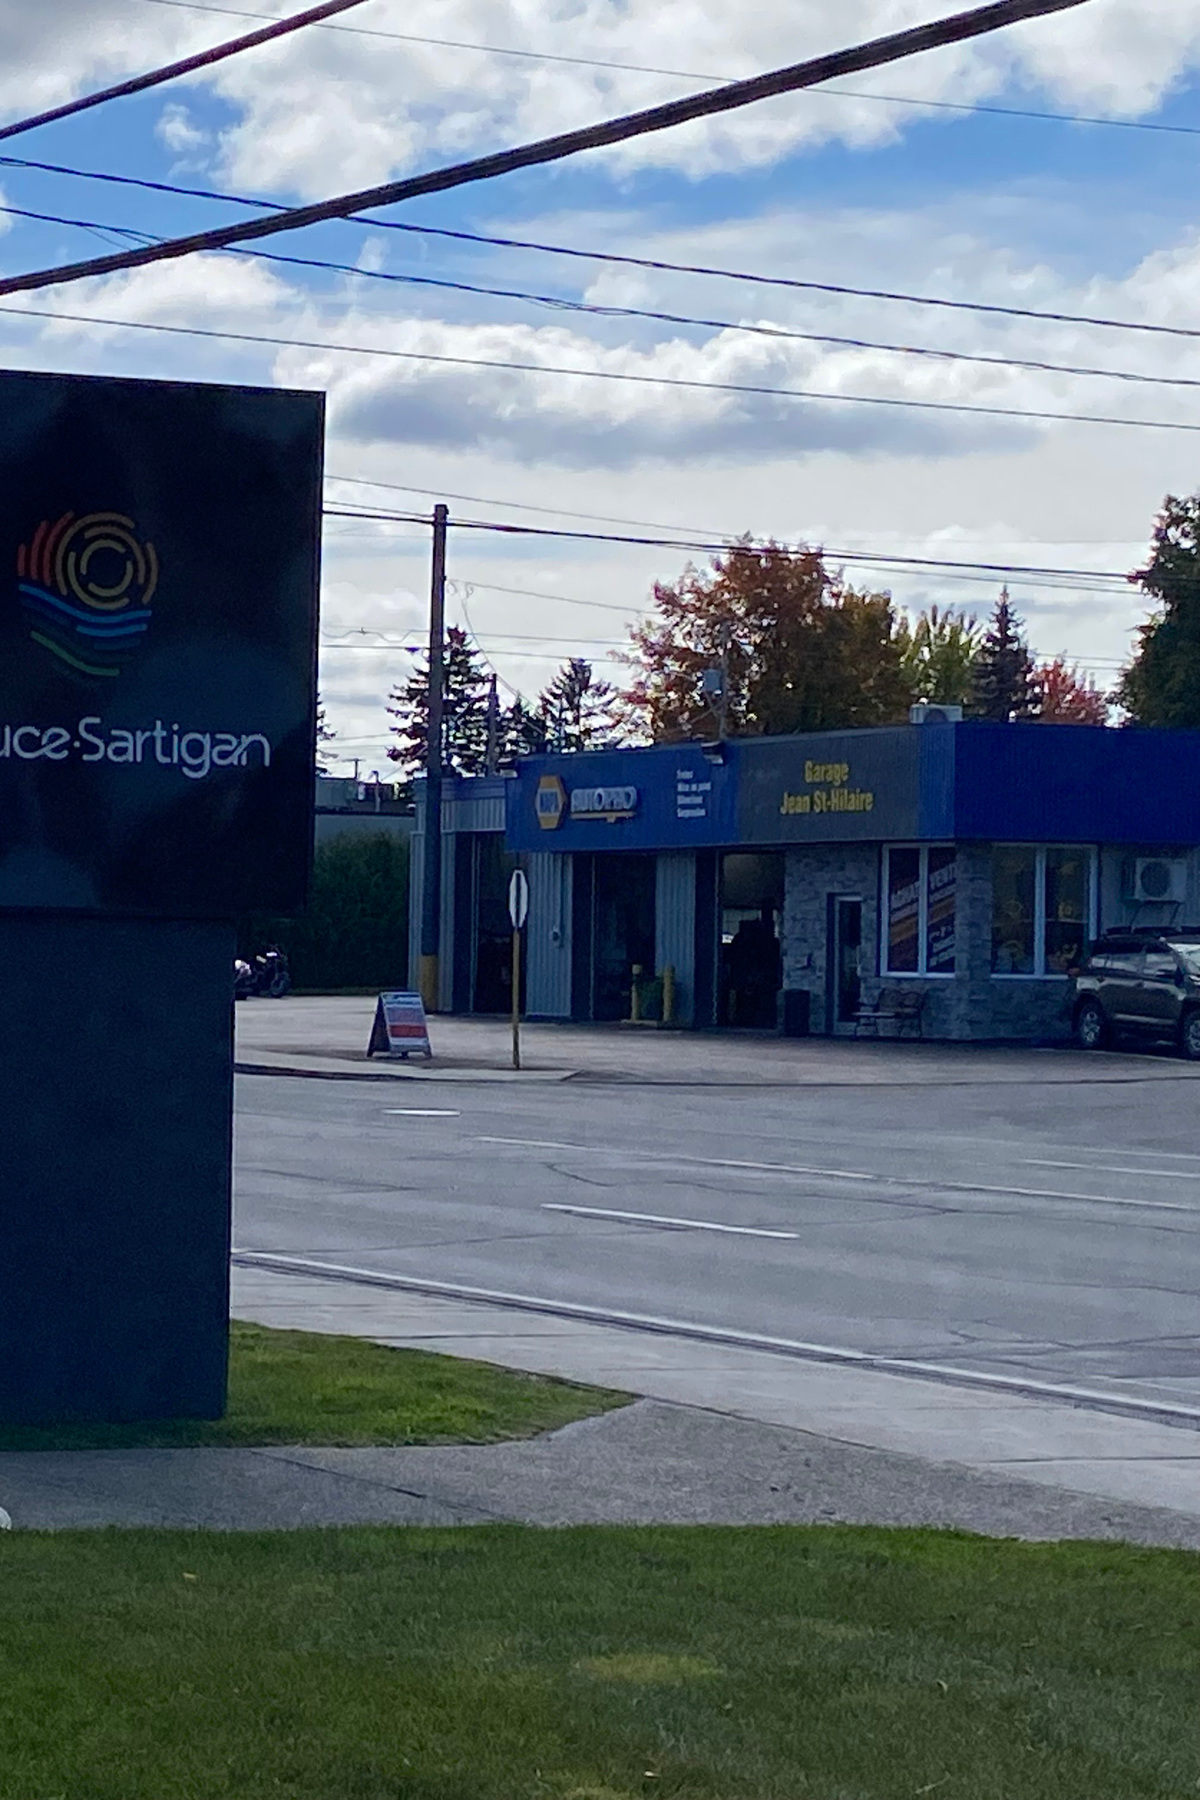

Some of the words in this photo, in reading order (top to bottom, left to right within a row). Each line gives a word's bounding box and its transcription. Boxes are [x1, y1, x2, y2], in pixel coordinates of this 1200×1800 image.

[804, 760, 850, 787] Garage
[780, 791, 811, 815] Jean
[813, 788, 874, 813] St-Hilaire
